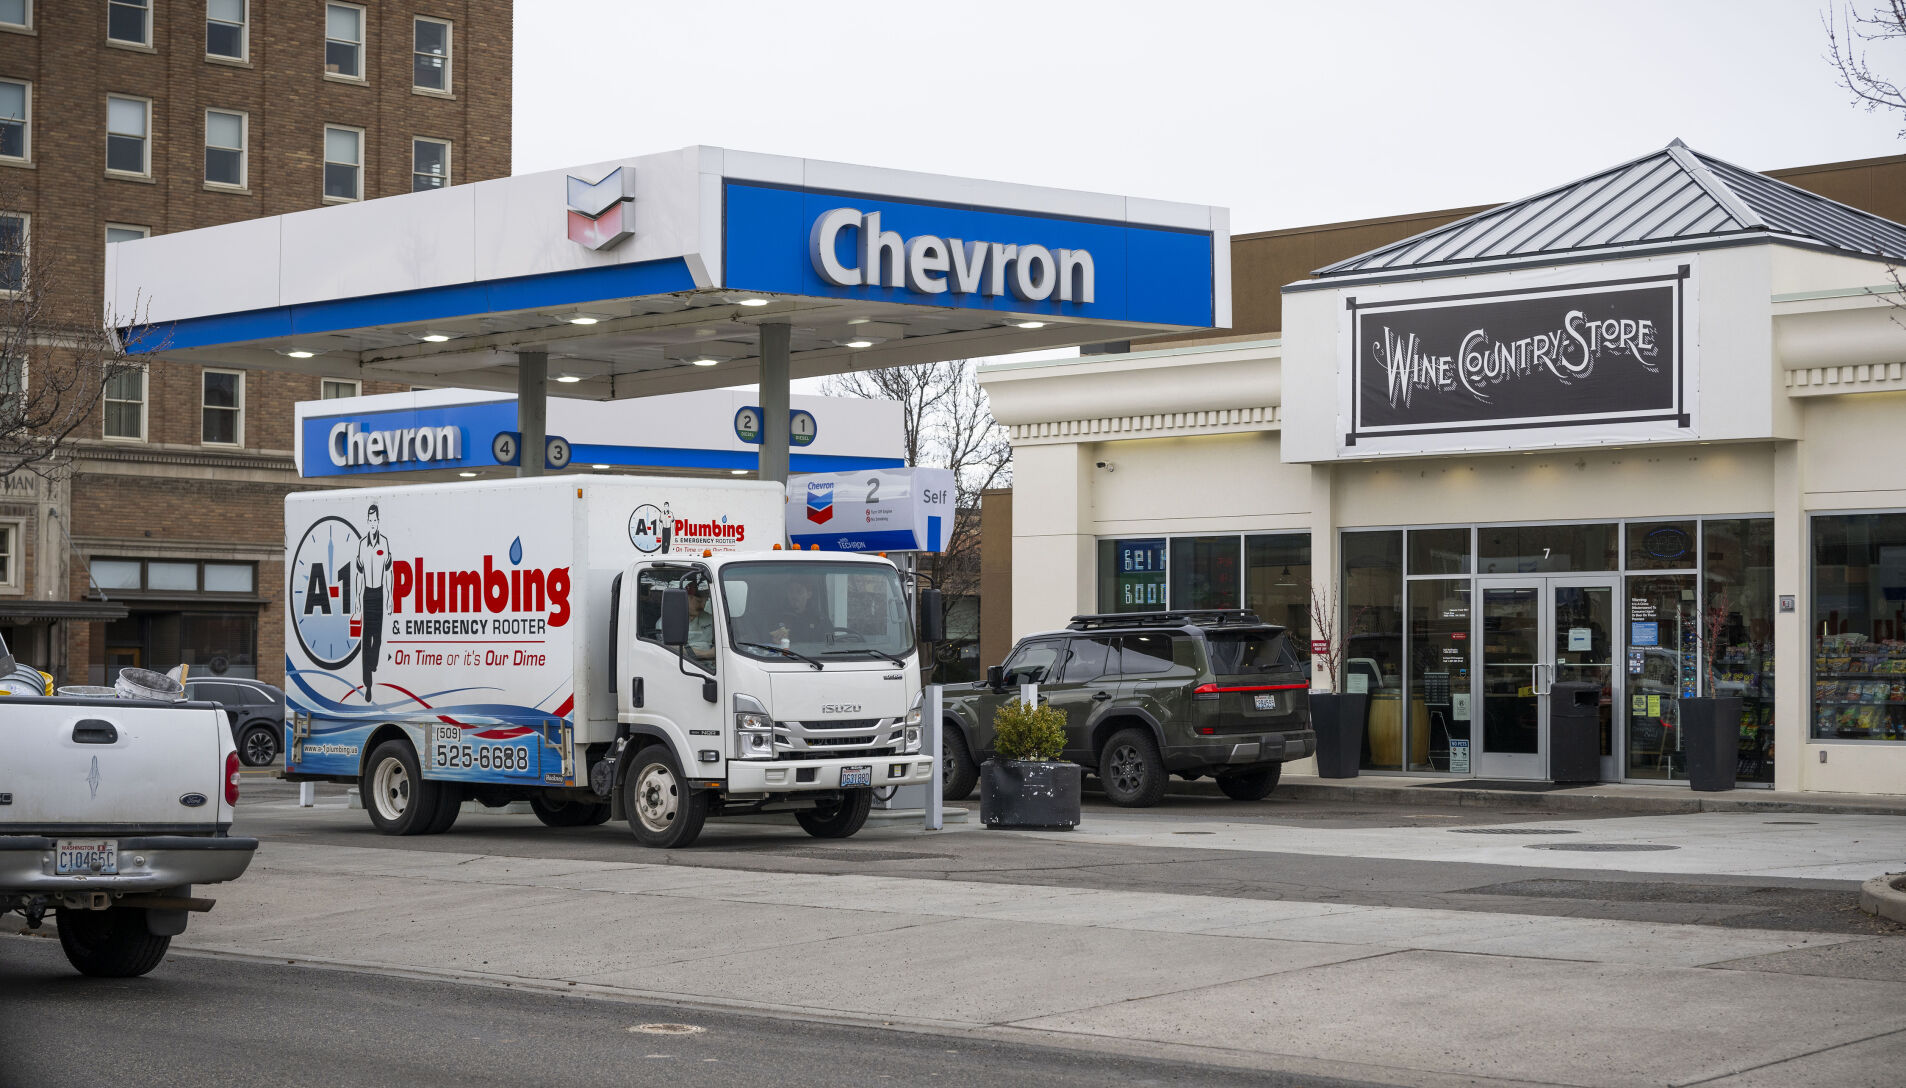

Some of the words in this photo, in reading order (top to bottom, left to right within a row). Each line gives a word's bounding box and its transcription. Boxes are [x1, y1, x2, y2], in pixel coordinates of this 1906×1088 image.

[809, 207, 1095, 304] Chevron
[743, 415, 752, 429] 2
[800, 418, 805, 432] 1
[328, 422, 462, 467] Chevron
[499, 440, 510, 456] 4
[553, 445, 563, 461] 3
[807, 481, 834, 490] Chevron
[865, 477, 880, 504] 2
[923, 489, 947, 504] Self
[635, 518, 658, 536] A-1
[674, 518, 745, 542] Plumbing
[1543, 547, 1550, 560] 7
[303, 560, 351, 615] A-1
[392, 555, 571, 627] Plumbing
[392, 620, 401, 635] &
[405, 620, 488, 635] EMERGENCY
[492, 619, 546, 634] ROOTER
[394, 650, 411, 666] On
[415, 650, 443, 666] Time
[446, 652, 460, 666] or
[463, 650, 481, 666] it's
[485, 650, 509, 666] Our
[513, 650, 546, 666] Dime
[436, 727, 460, 742] (509)
[437, 744, 528, 771] 525-6688
